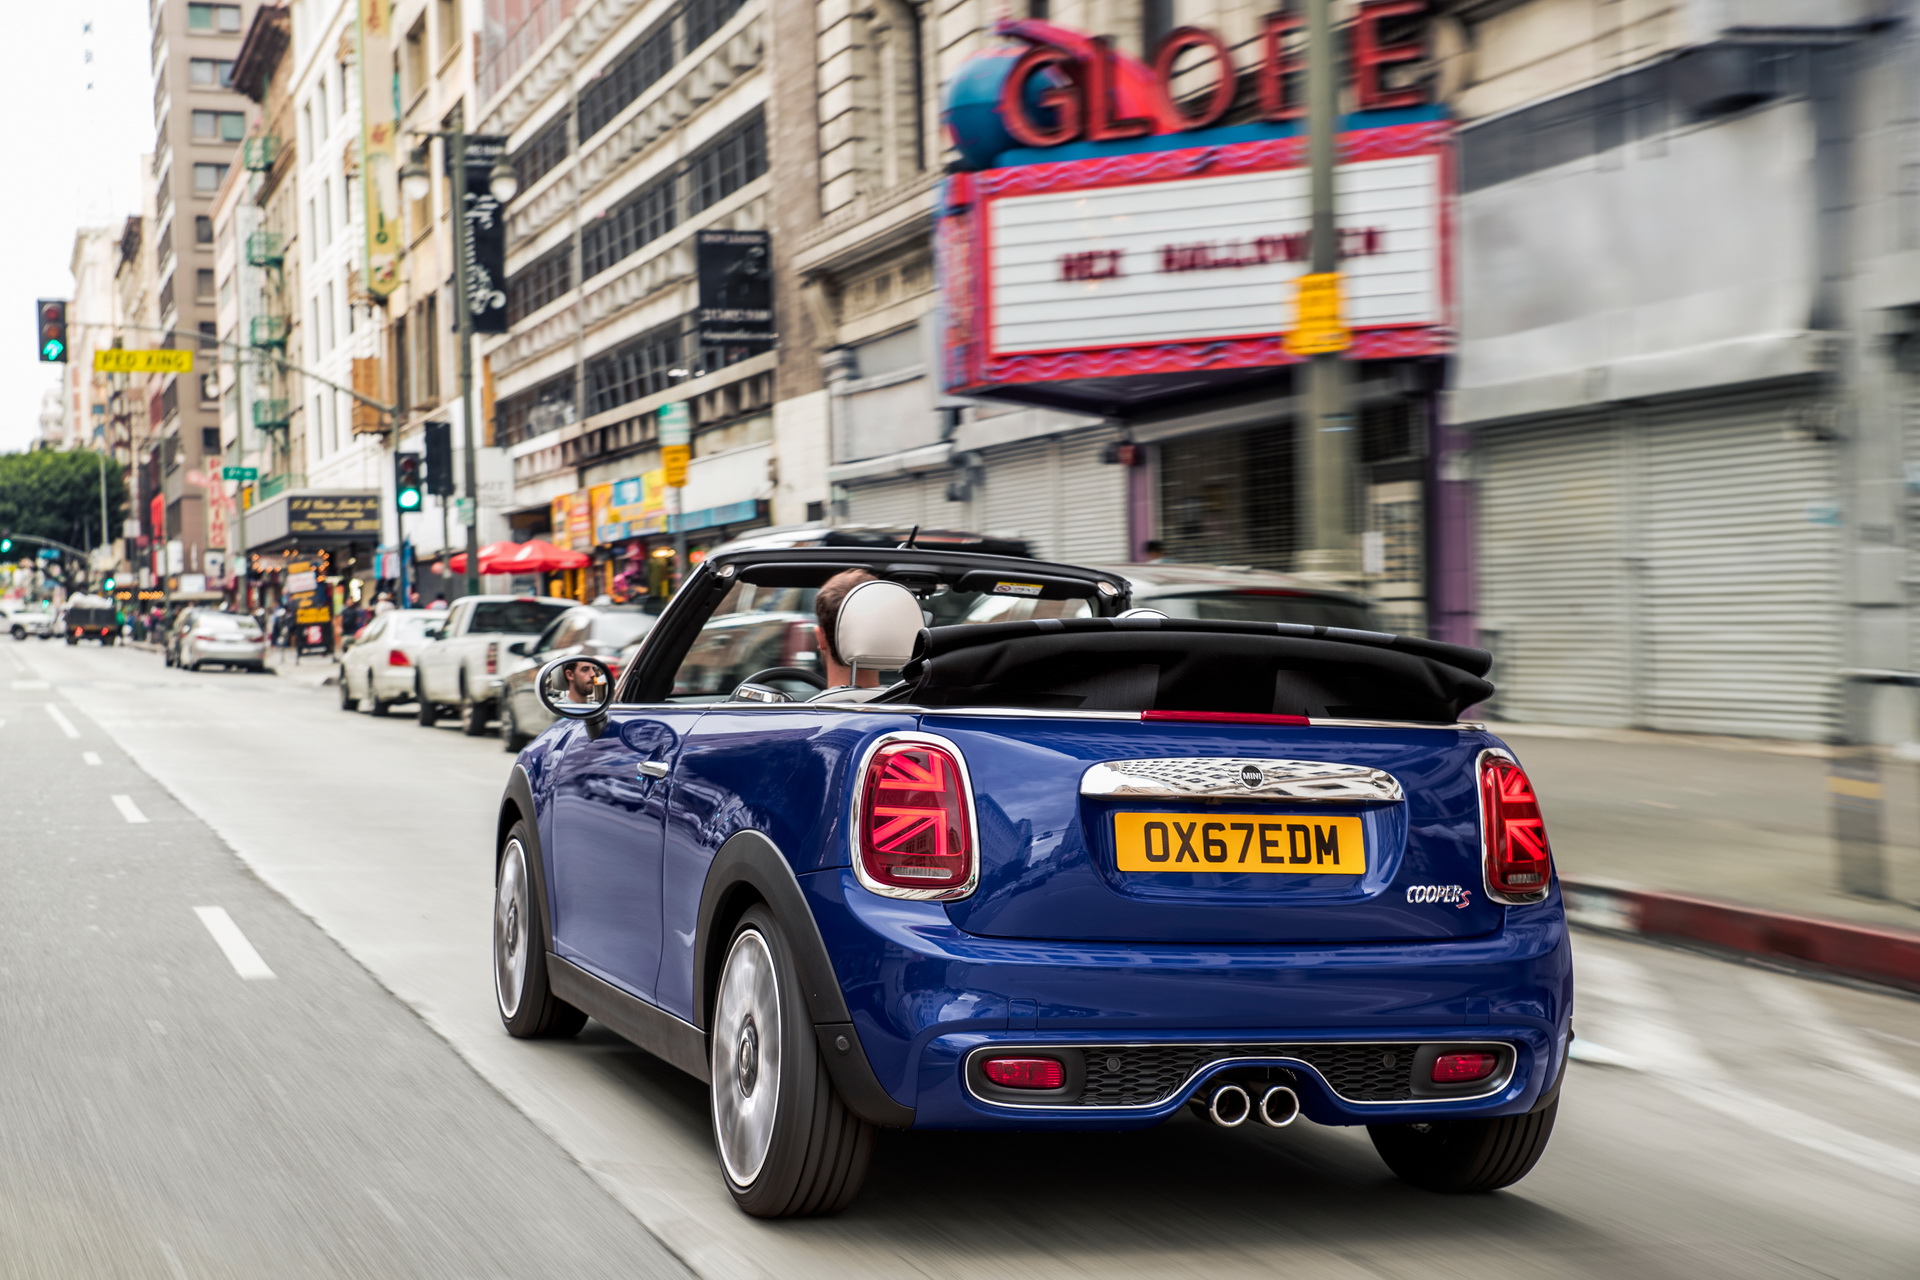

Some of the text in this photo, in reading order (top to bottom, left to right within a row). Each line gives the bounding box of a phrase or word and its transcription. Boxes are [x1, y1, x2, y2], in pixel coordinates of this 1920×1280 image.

[103, 353, 184, 369] PED XING
[1242, 772, 1262, 780] MINI
[1144, 821, 1340, 865] OX67EDM
[1406, 884, 1462, 904] COOPER
